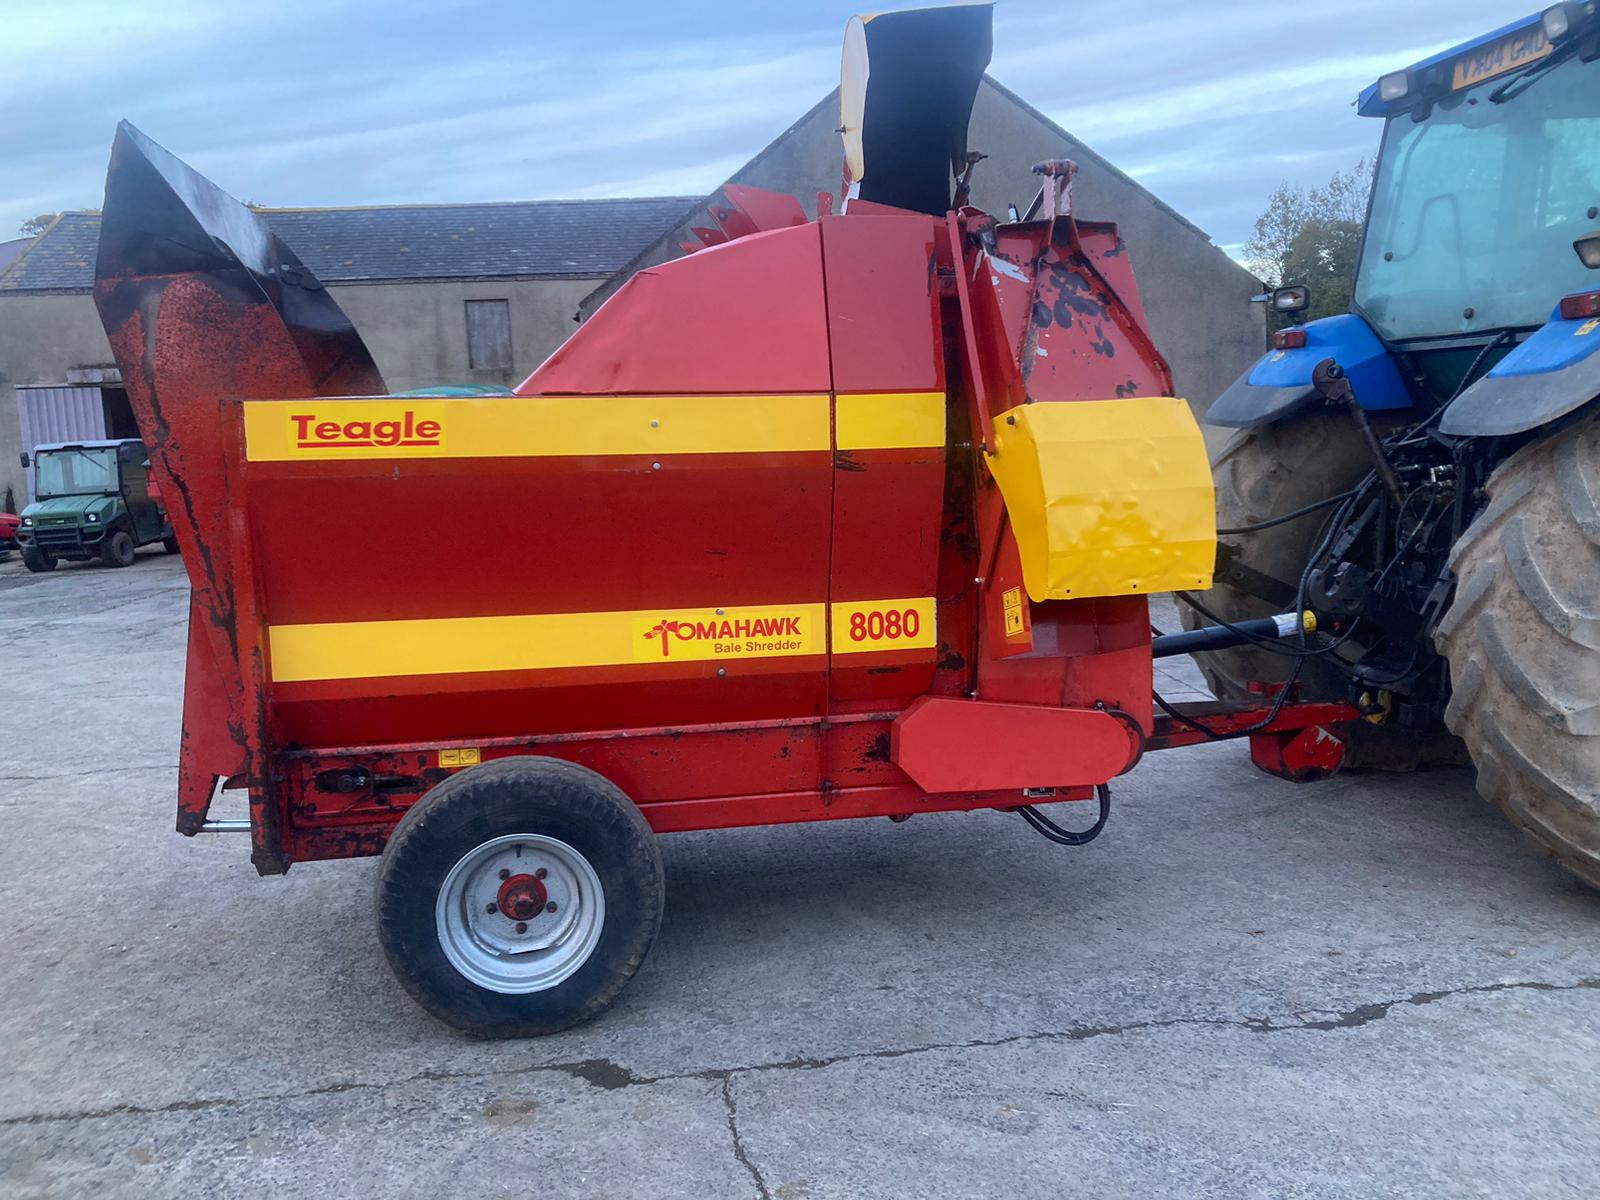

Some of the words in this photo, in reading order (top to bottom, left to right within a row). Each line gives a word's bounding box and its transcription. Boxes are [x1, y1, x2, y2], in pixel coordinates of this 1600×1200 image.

[291, 411, 441, 447] Teagle
[849, 608, 919, 642] 8080
[714, 643, 742, 654] Bale
[745, 640, 802, 652] Shredder
